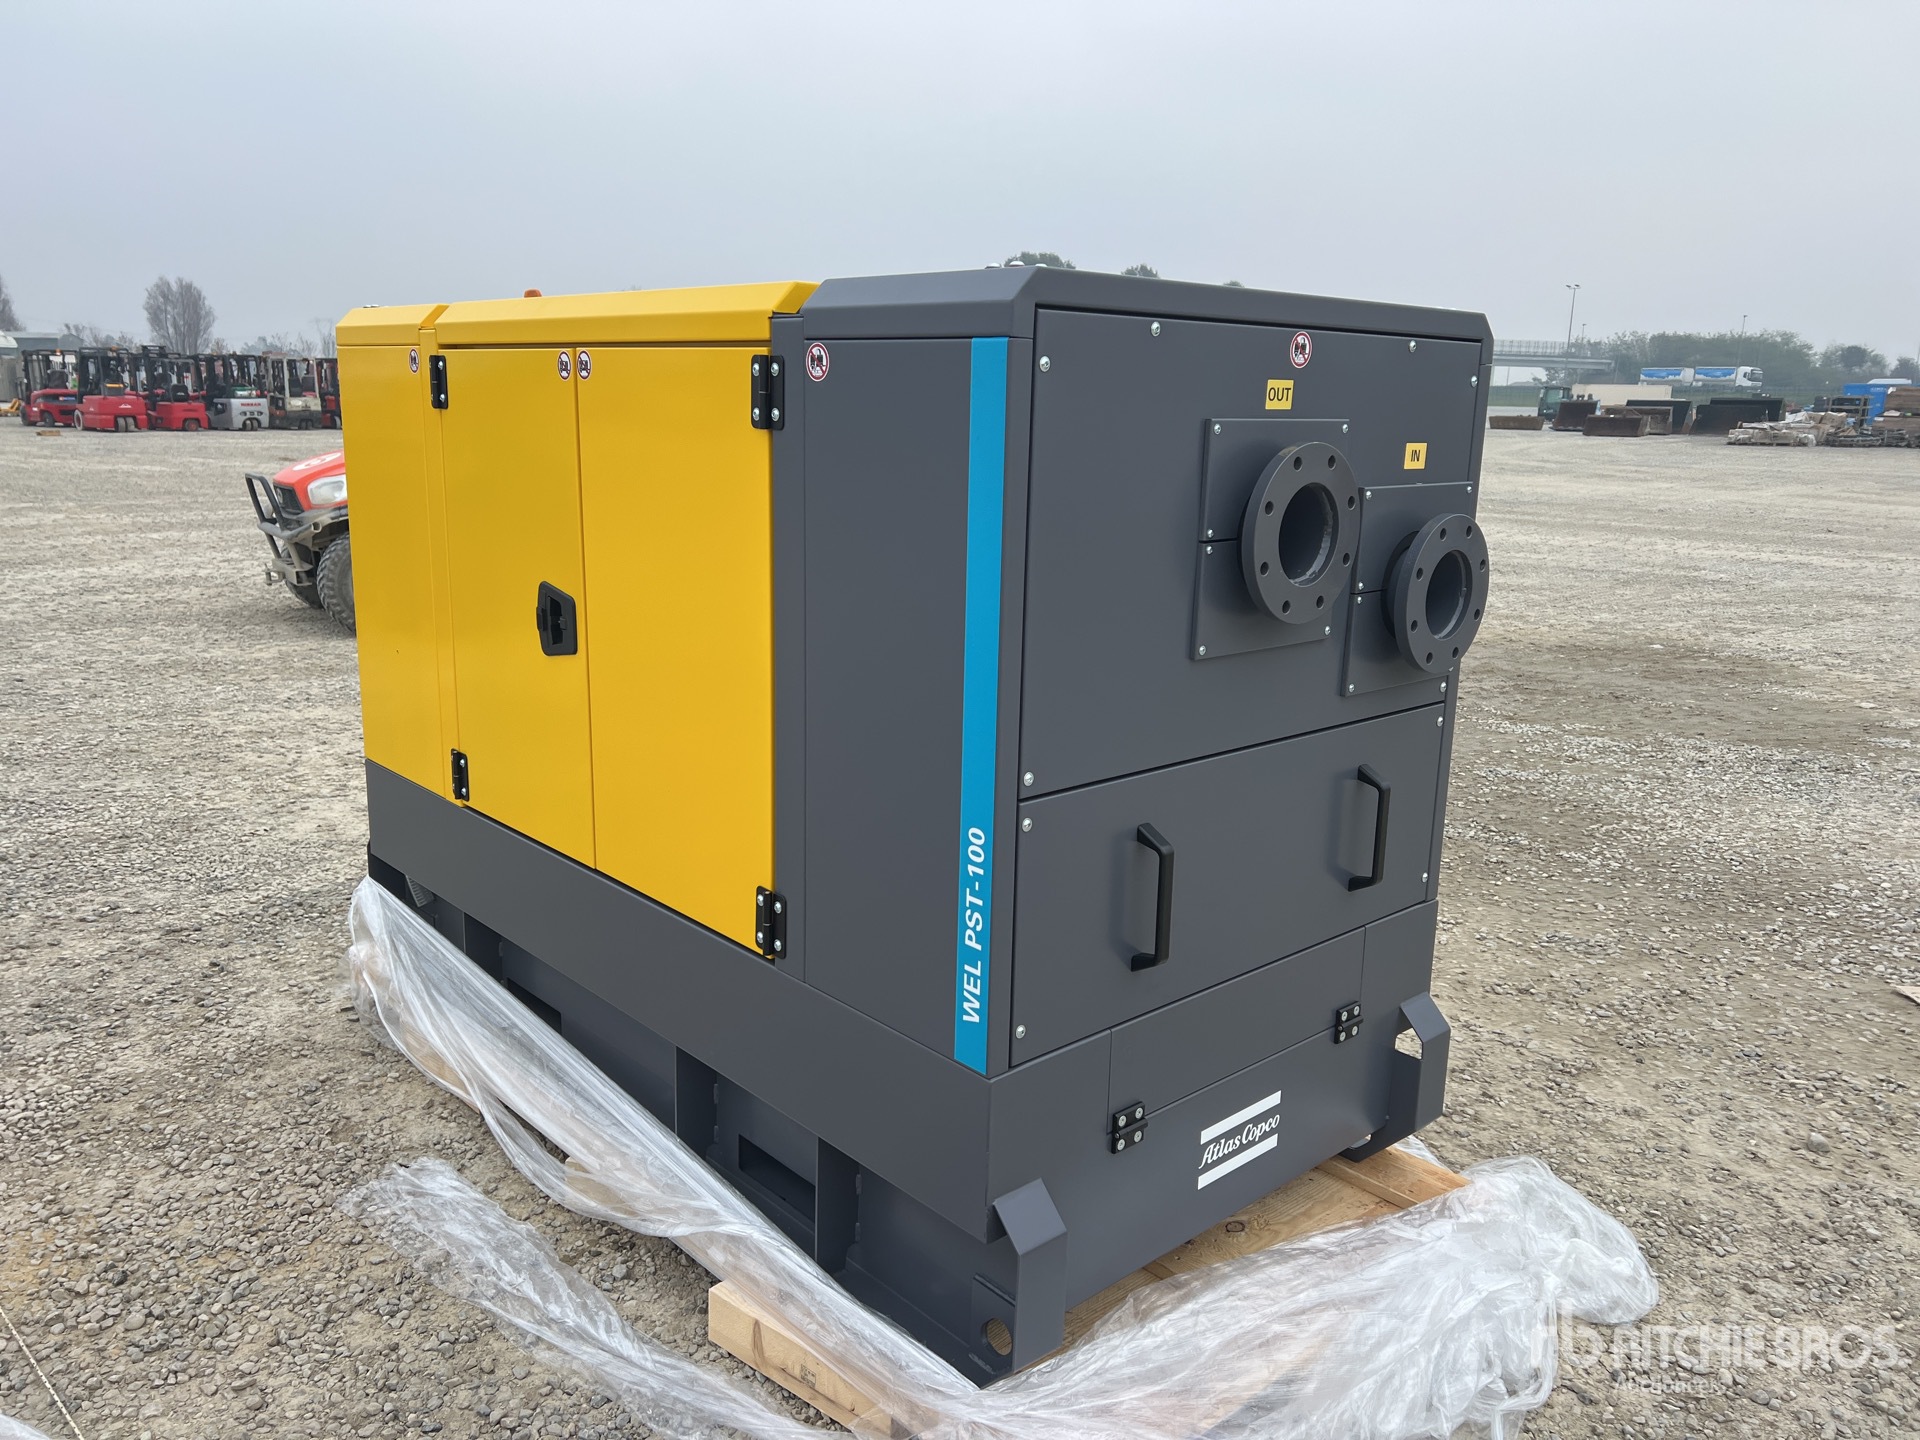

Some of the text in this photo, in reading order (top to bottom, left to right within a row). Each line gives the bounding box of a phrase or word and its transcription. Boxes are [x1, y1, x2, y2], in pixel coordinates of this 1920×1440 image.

[1267, 387, 1292, 402] OUT
[1410, 449, 1421, 462] IN
[962, 827, 986, 1023] WEL PST-100
[1198, 1114, 1280, 1170] Atlas Copco
